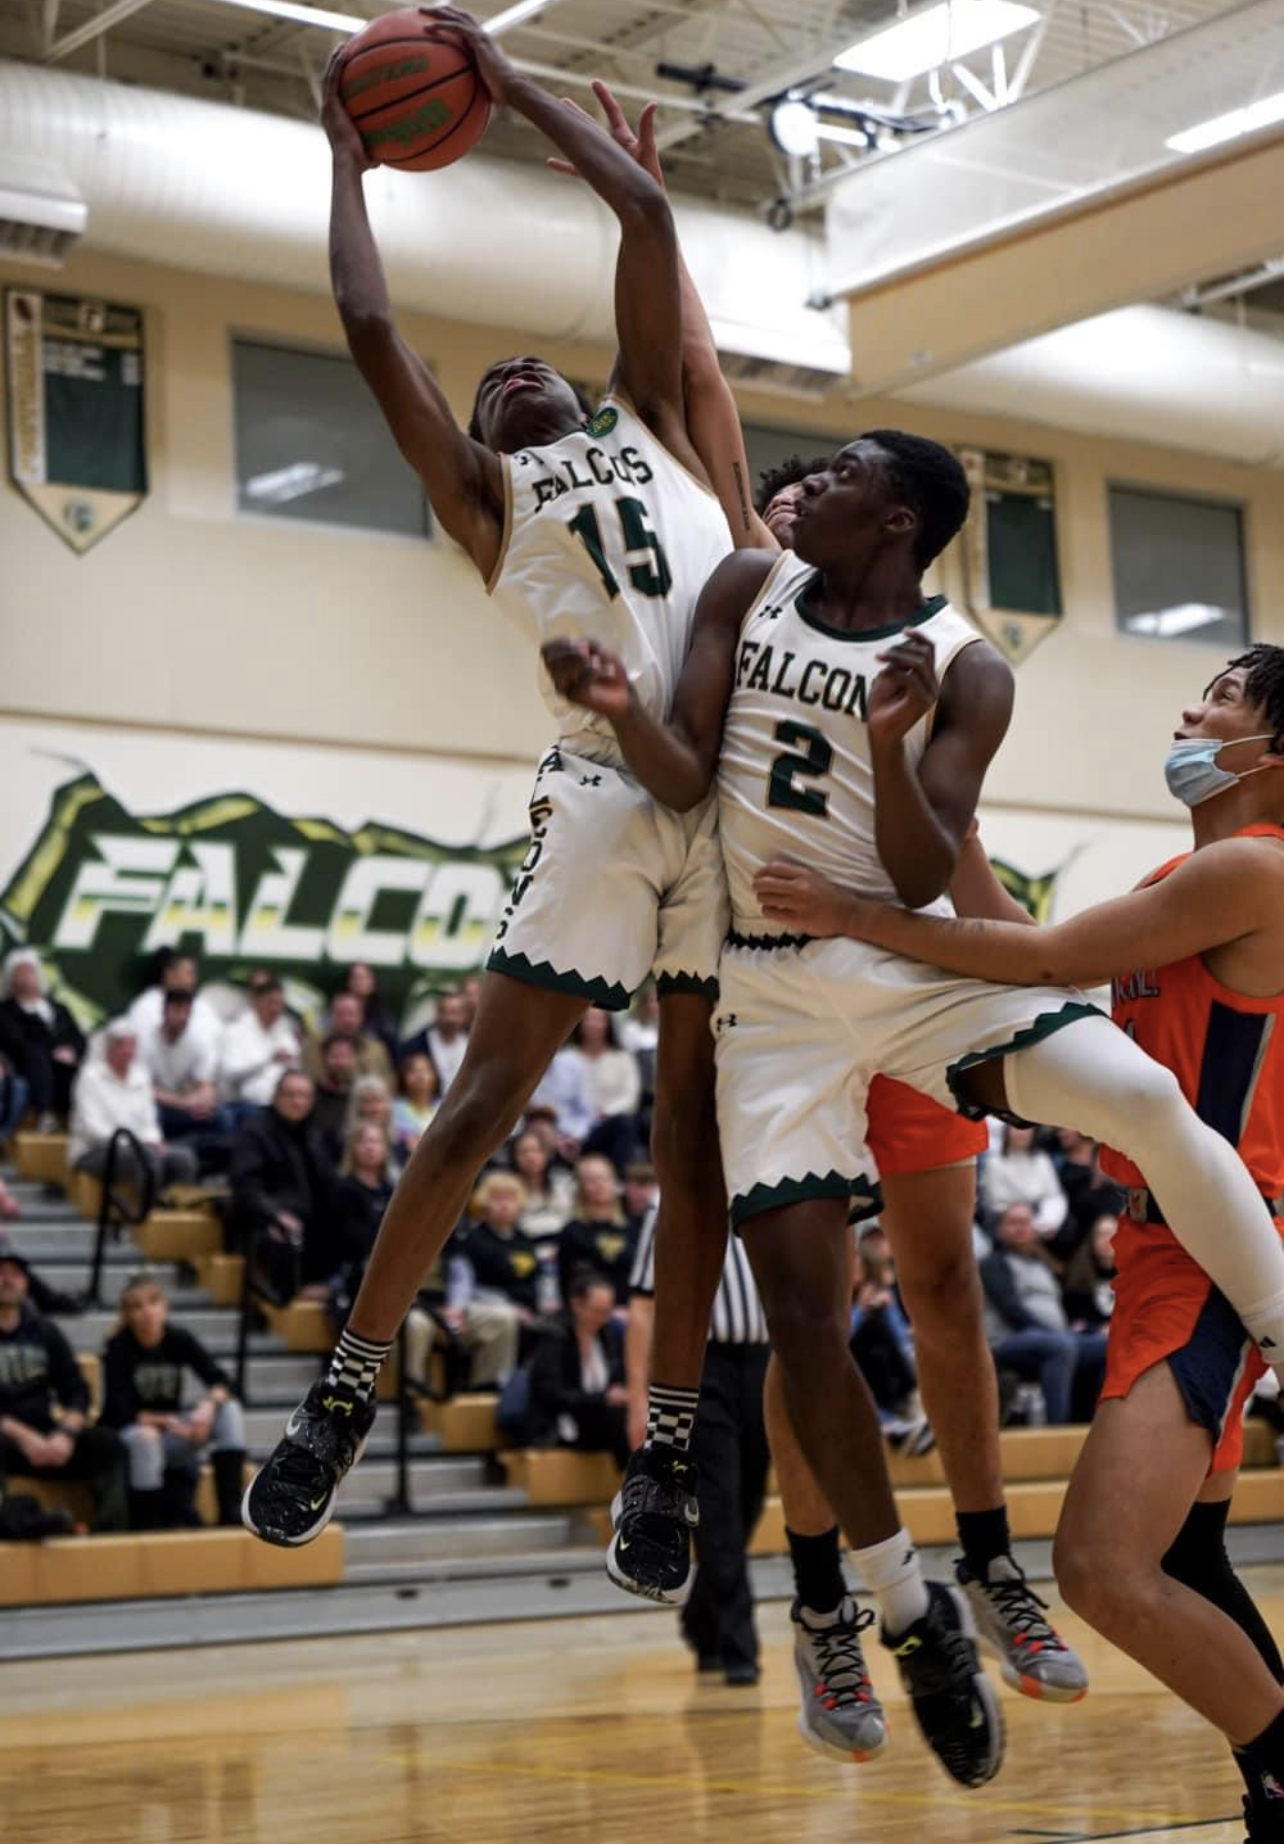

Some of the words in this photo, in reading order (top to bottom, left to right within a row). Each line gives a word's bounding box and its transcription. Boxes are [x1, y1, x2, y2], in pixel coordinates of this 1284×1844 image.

[567, 496, 673, 602] 15
[737, 641, 868, 723] FALCON
[768, 719, 833, 818] 2
[54, 833, 503, 969] FALCO
